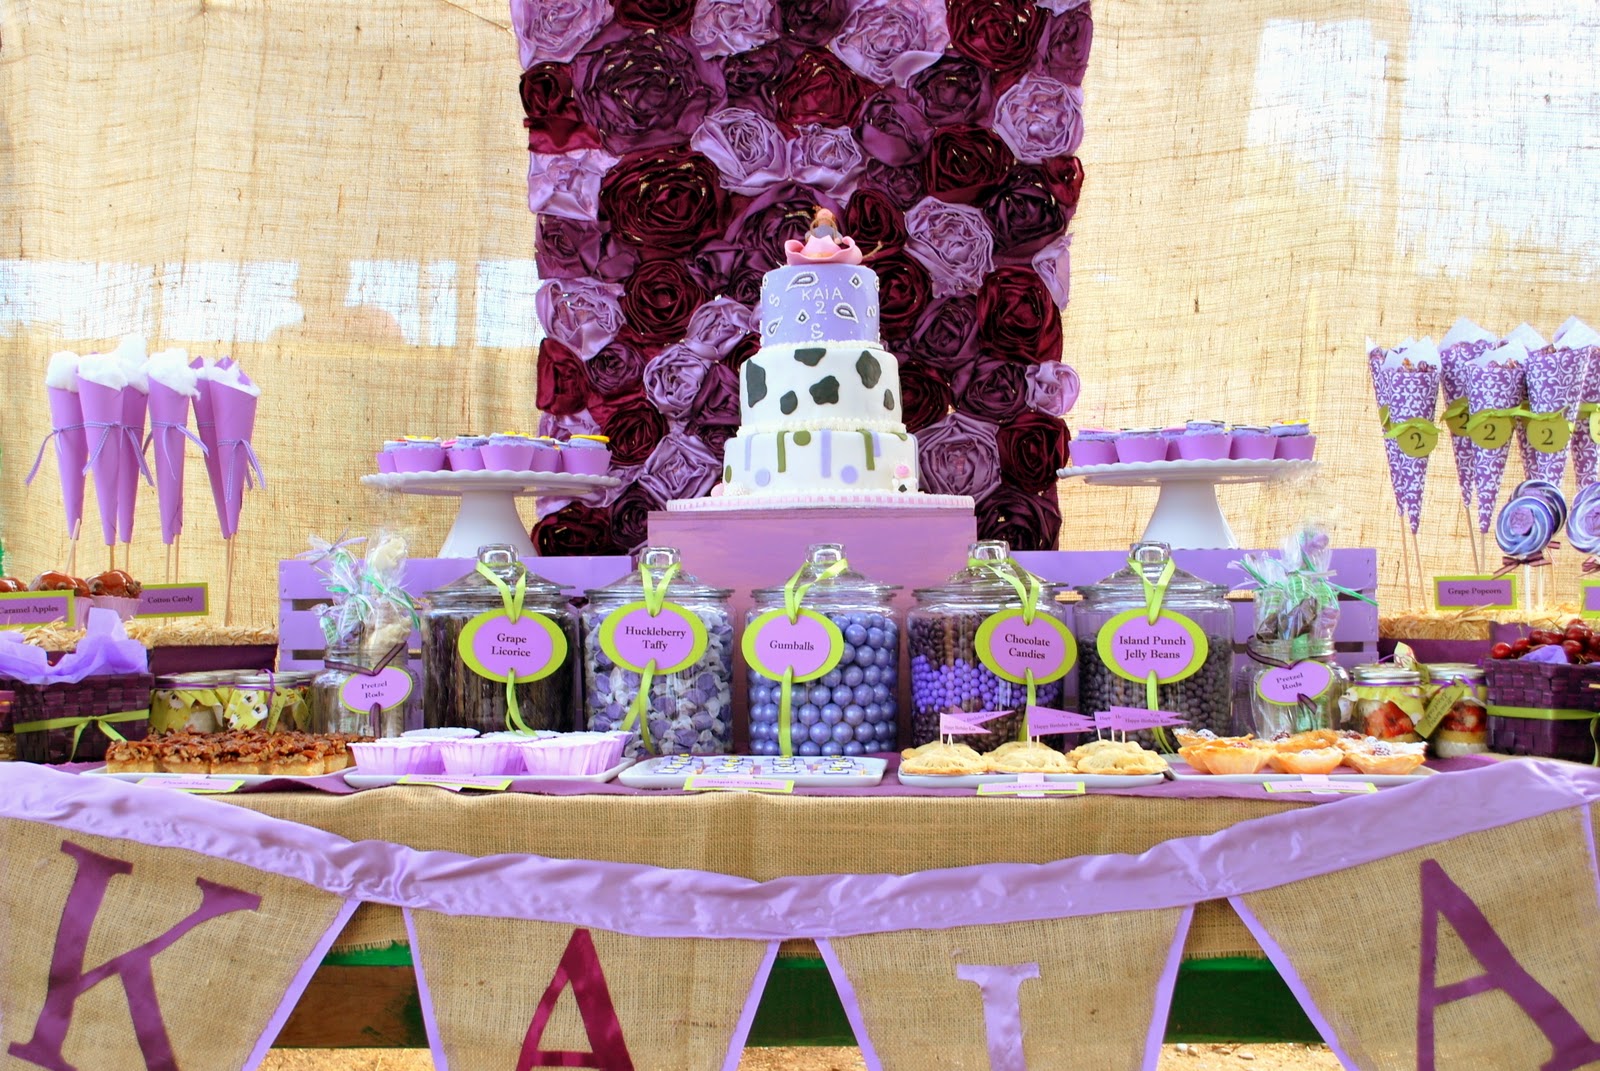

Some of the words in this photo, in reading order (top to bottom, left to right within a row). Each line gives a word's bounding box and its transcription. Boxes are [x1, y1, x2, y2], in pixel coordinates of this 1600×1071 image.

[815, 301, 826, 314] 2
[1458, 413, 1470, 430] 2
[1484, 423, 1496, 441] 2
[1541, 428, 1554, 445] 2
[1410, 432, 1425, 450] 2
[1448, 588, 1469, 596] Grape
[1471, 587, 1502, 596] Popcorn
[147, 596, 170, 604] Cotton
[172, 595, 193, 603] Candy
[0, 606, 30, 614] Caramel
[32, 605, 59, 614] Apples
[625, 626, 686, 639] Huckleberry
[497, 633, 527, 645] Grape
[1005, 633, 1051, 646] Chocolate
[1119, 635, 1149, 645] Island
[1152, 635, 1187, 645] Punch
[491, 645, 531, 657] Licorice
[642, 640, 668, 652] Taffy
[769, 640, 815, 651] Gumballs
[1009, 647, 1046, 659] Candies
[1124, 649, 1147, 661] Jelly
[1150, 649, 1181, 659] Beans
[1276, 672, 1304, 683] Pretzel
[361, 681, 388, 689] Pretzel
[1282, 682, 1302, 690] Rods
[365, 691, 384, 699] Rods
[8, 839, 262, 1071] K
[515, 928, 635, 1071] A
[1416, 858, 1600, 1071] A
